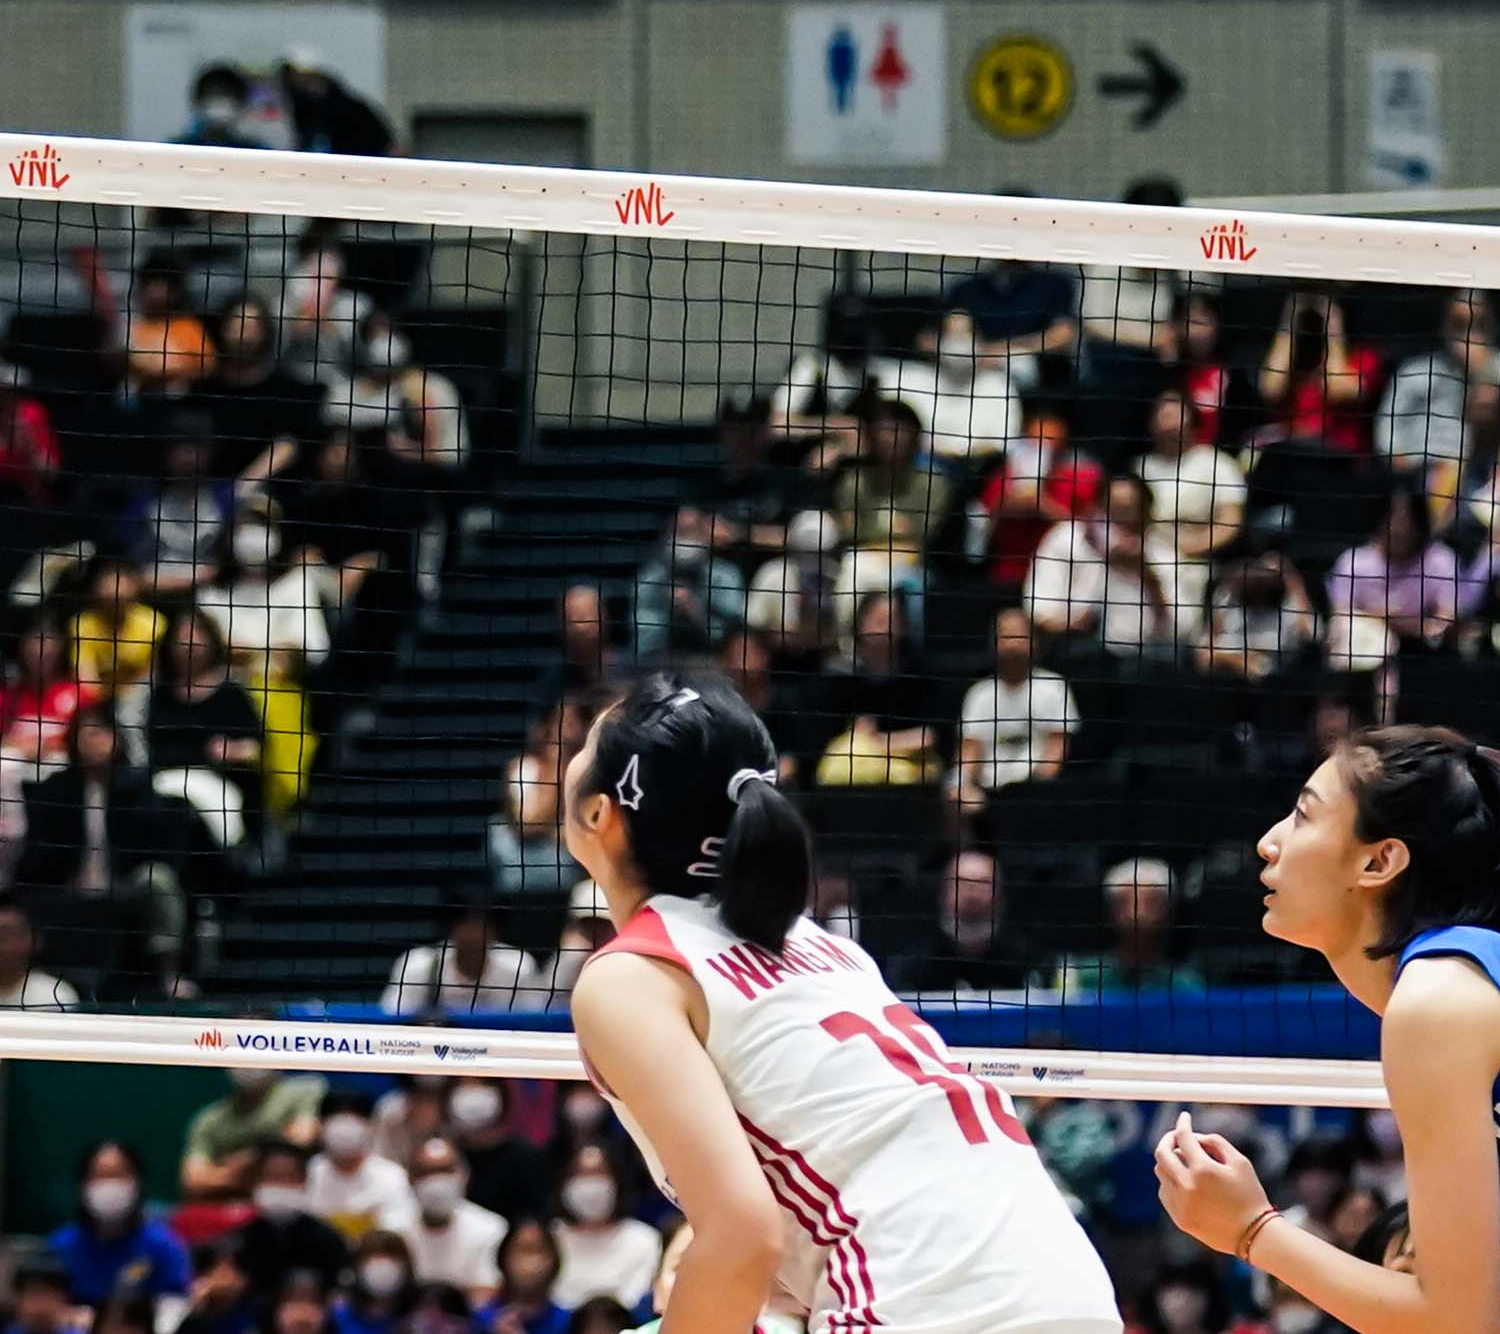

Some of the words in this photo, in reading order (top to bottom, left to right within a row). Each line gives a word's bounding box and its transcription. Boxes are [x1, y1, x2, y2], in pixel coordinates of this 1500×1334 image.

[8, 144, 70, 189] VNL
[614, 182, 675, 226] VNL
[1199, 219, 1258, 262] VNL
[236, 1033, 376, 1056] VOLLEYBALL
[379, 1038, 422, 1049] NATIONS
